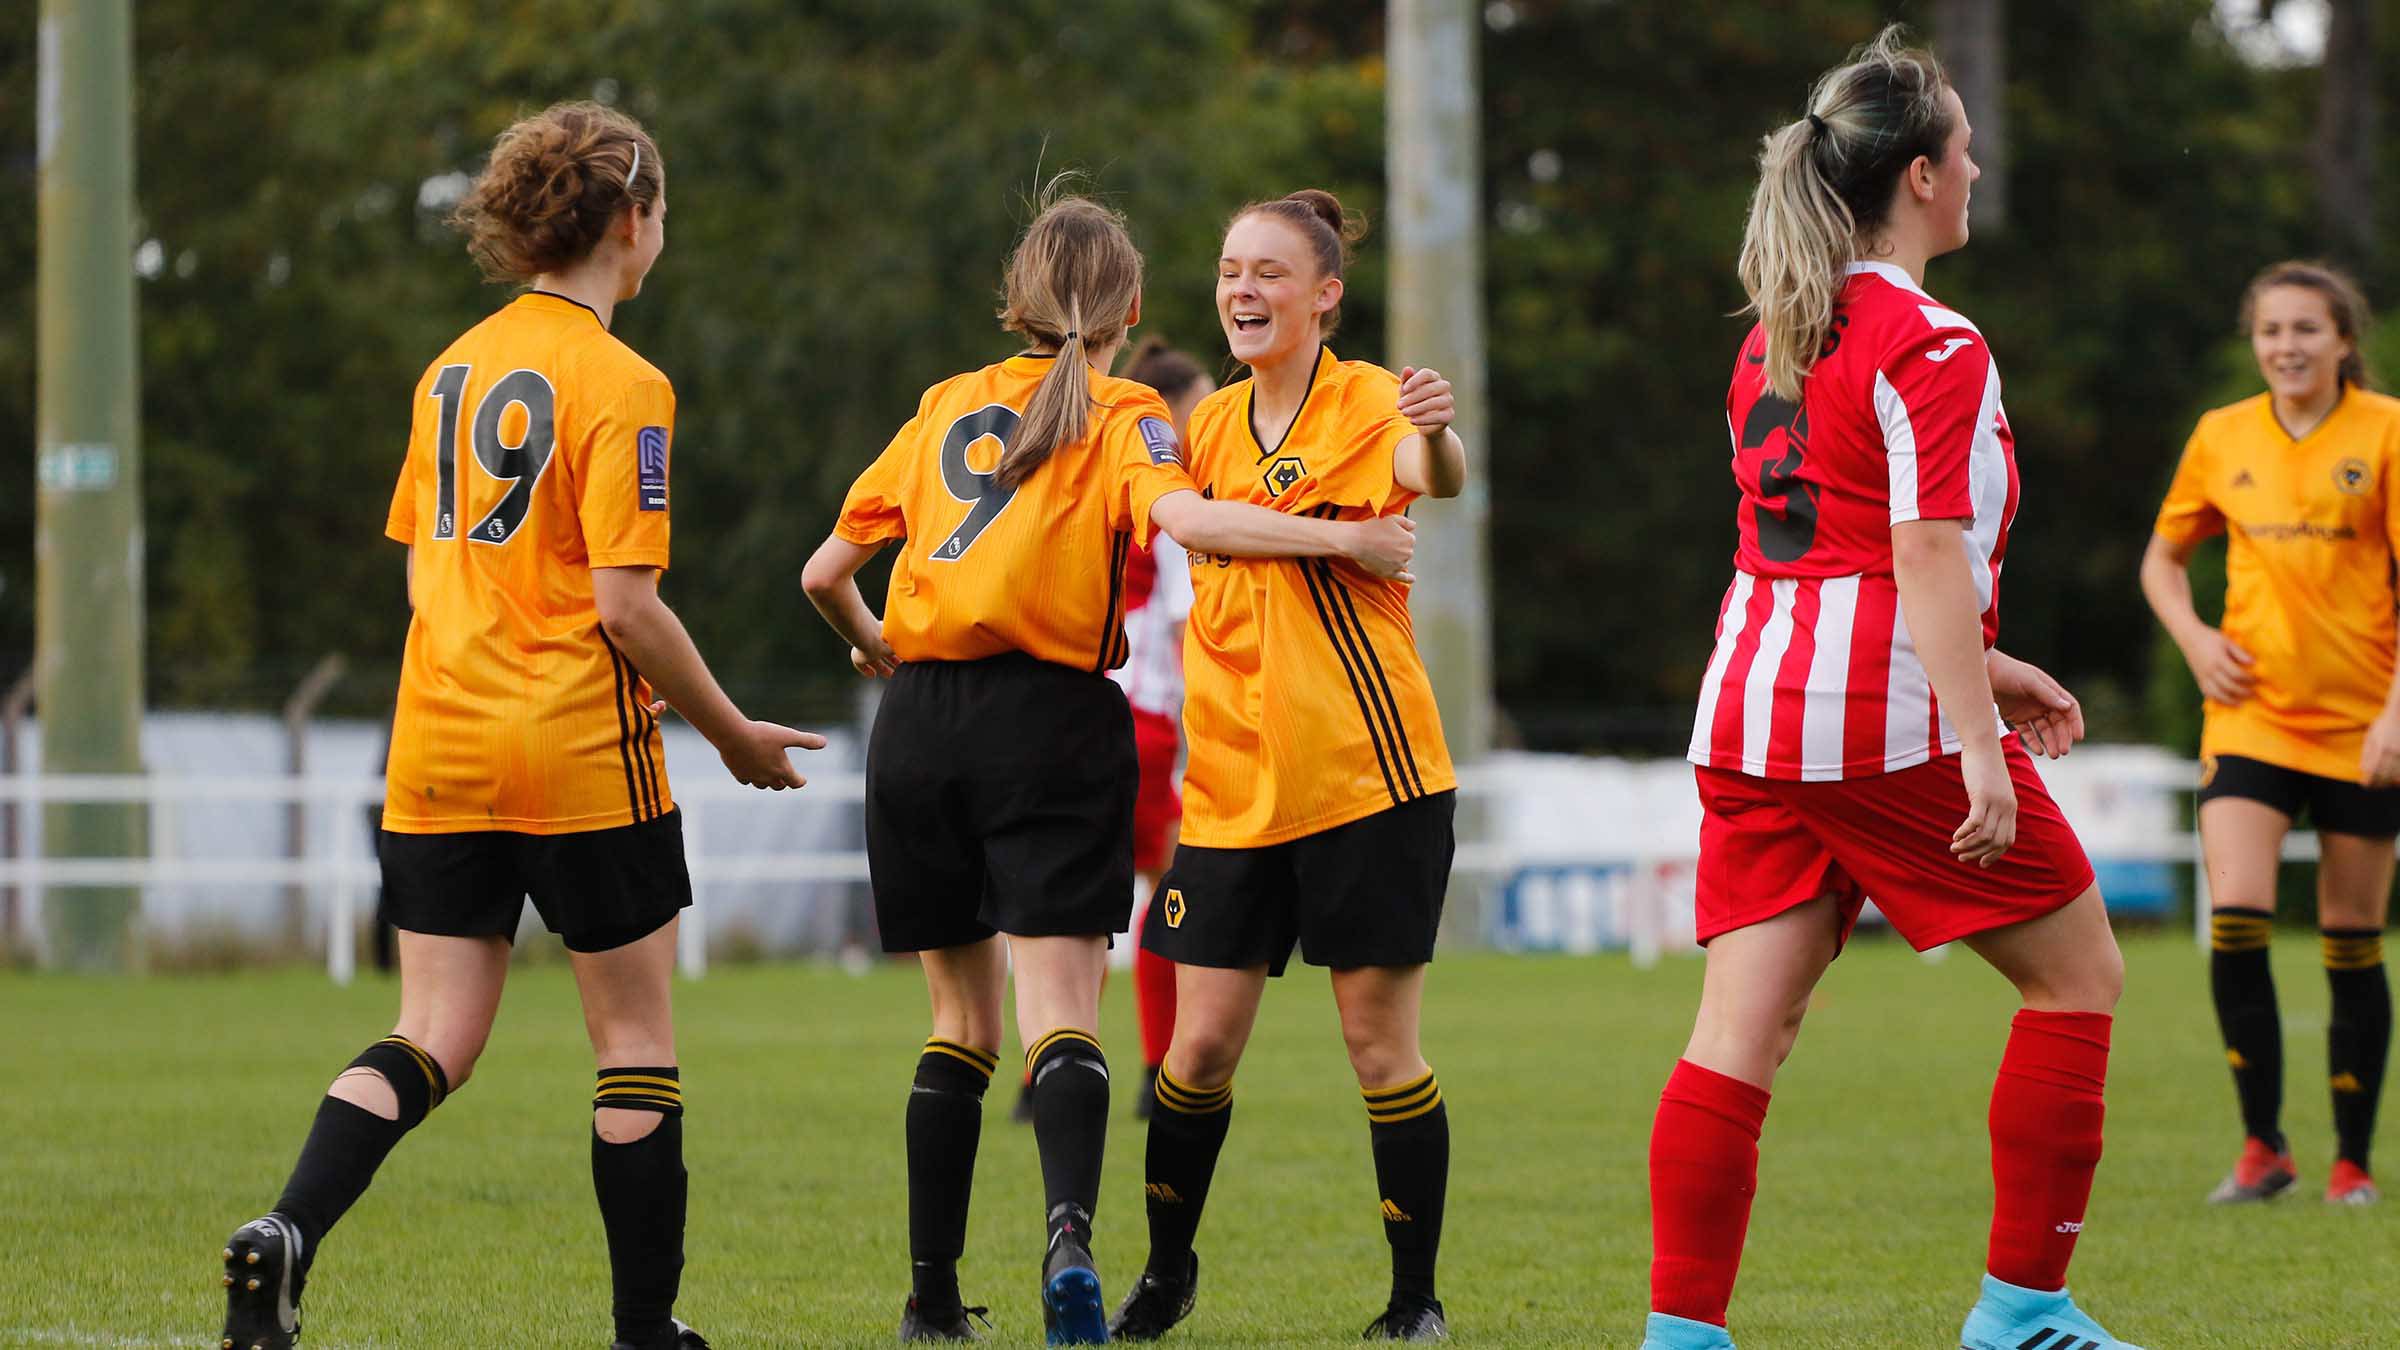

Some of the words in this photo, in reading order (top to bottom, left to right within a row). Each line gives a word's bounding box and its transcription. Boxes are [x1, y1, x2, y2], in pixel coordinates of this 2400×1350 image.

[429, 364, 556, 545] 19
[928, 403, 1022, 561] 9
[1742, 391, 1820, 562] 3
